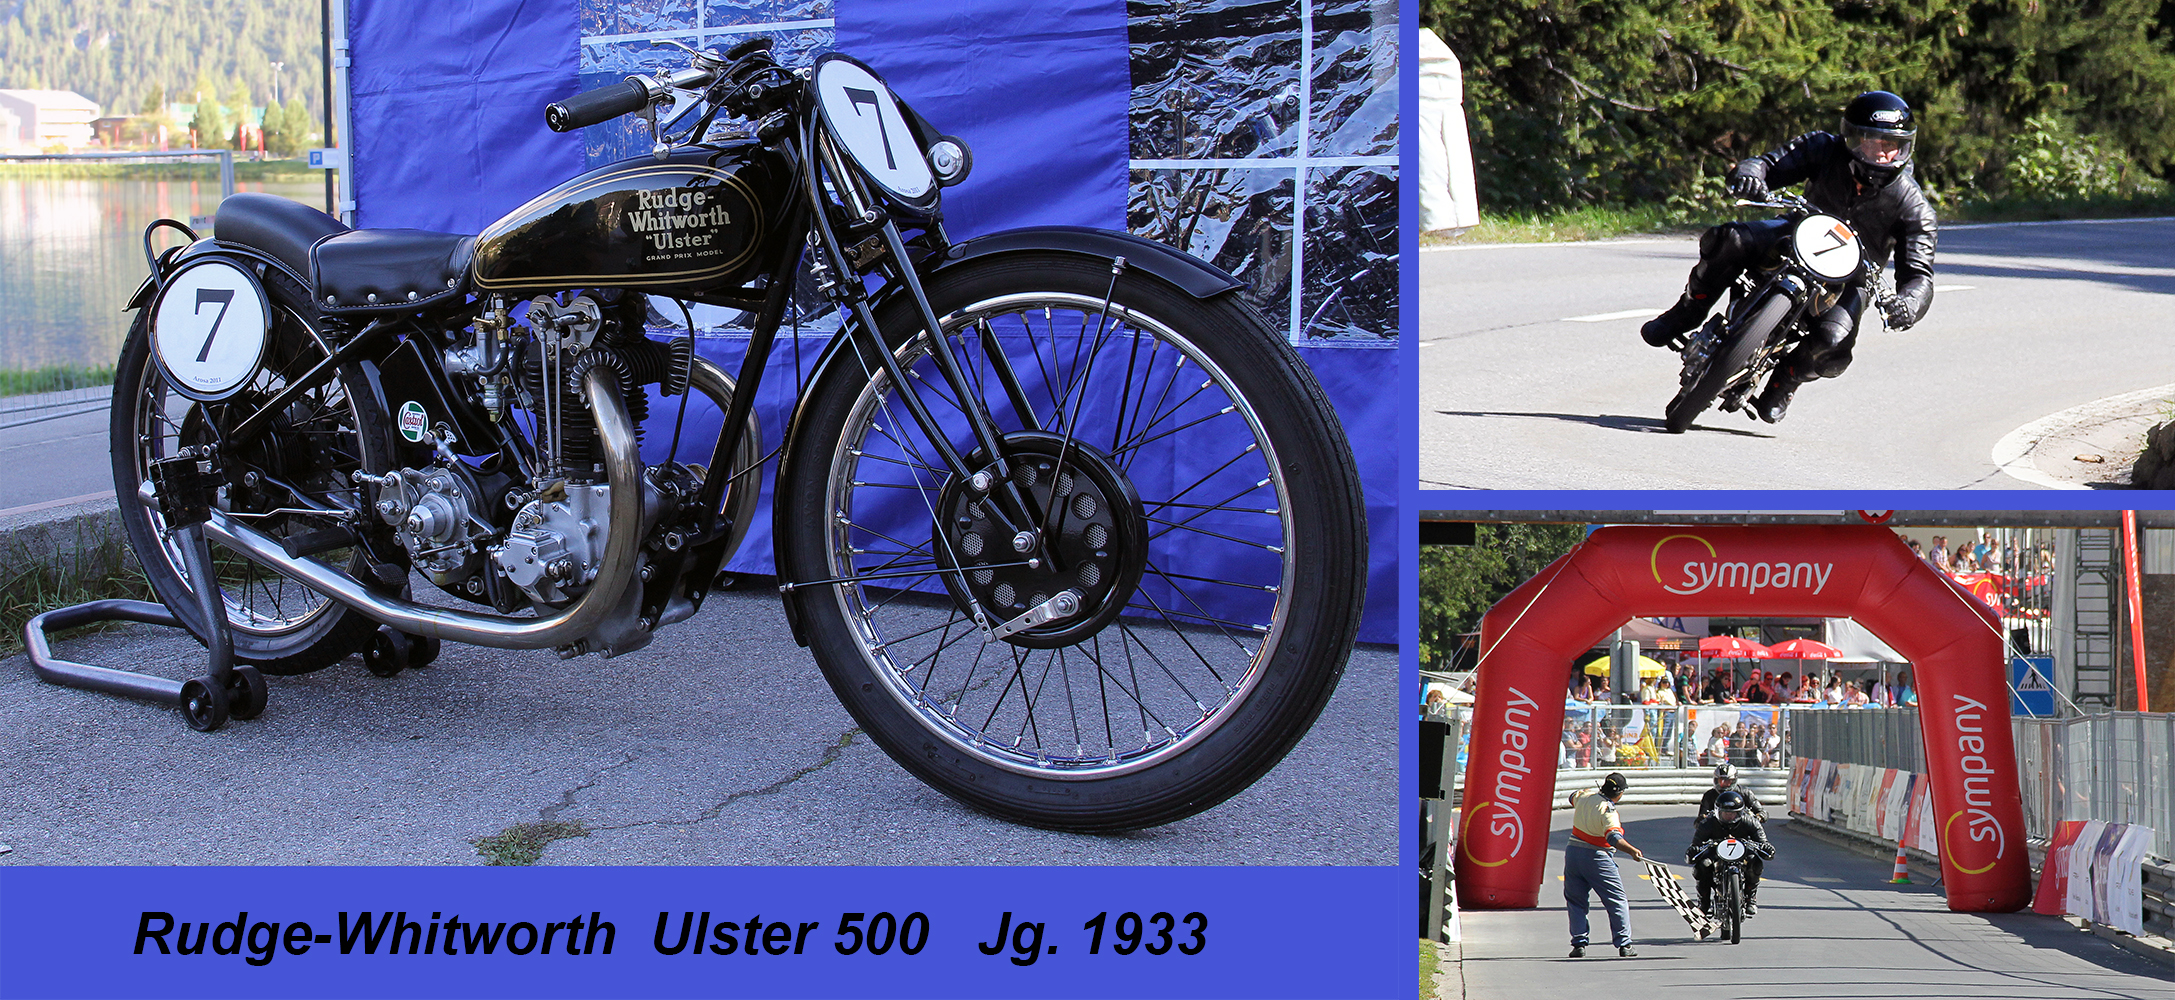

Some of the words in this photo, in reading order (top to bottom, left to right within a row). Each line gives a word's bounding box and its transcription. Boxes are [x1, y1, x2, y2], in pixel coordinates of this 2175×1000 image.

[842, 86, 898, 171] 7
[312, 153, 321, 164] P
[638, 186, 714, 212] Rudge-
[627, 204, 731, 233] Whitworth
[645, 254, 671, 262] GRAND
[674, 252, 692, 260] PRIX
[696, 249, 724, 257] MODEL
[1812, 228, 1848, 257] 7
[194, 288, 235, 363] 7
[192, 375, 208, 384] Arosa
[1664, 561, 1834, 595] sympany
[1490, 686, 1540, 858] sympany
[1953, 694, 2005, 859] sympany
[1726, 843, 1737, 857] 7
